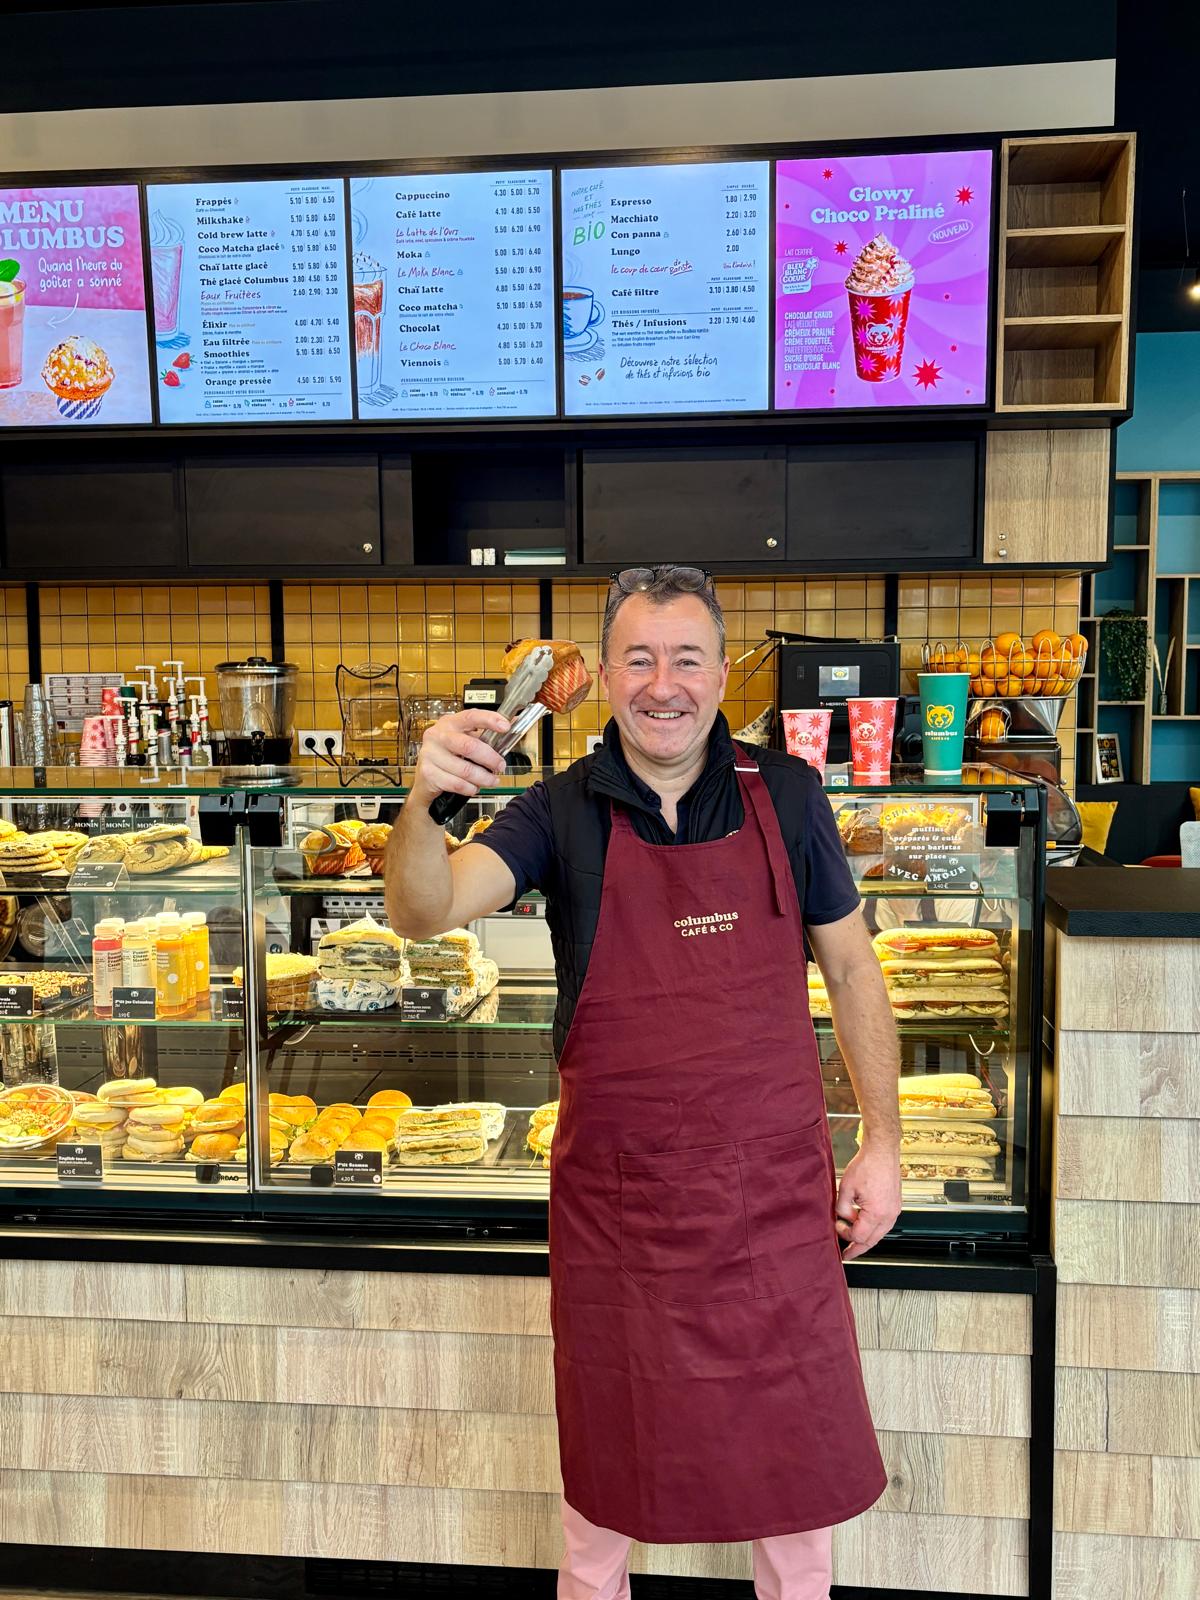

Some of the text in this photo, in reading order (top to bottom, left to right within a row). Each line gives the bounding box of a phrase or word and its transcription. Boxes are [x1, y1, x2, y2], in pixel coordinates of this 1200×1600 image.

[395, 192, 450, 201] Cappuccino
[511, 188, 523, 196] 5.00
[849, 187, 914, 203] Glowy
[195, 198, 232, 207] Frappés
[322, 196, 335, 204] 6.50
[611, 198, 652, 207] Espresso
[0, 200, 84, 224] MENU
[396, 210, 441, 219] Café latte
[811, 203, 945, 224] Choco Praliné
[196, 216, 244, 225] Milkshake
[290, 213, 336, 222] 5.10 6.50
[611, 214, 659, 224] Macchiato
[197, 230, 268, 240] Cold brew latte
[396, 228, 404, 237] Le
[406, 227, 427, 236] Latte
[429, 227, 438, 236] de
[611, 231, 661, 240] Con panna
[726, 228, 740, 237] 2.60
[931, 221, 969, 241] NOUVEAU
[0, 226, 125, 250] LUMBUS
[199, 243, 280, 254] Coco Matcha glacé
[324, 243, 337, 252] 6.50
[726, 244, 740, 252] 2.00
[397, 251, 423, 259] Moka
[611, 248, 641, 257] Lungo
[38, 256, 123, 273] Quand l'heure du
[199, 261, 268, 272] Chaï latte glacé
[325, 261, 337, 269] 6.50
[611, 264, 619, 274] le
[620, 267, 638, 276] coup
[639, 264, 649, 274] de
[669, 260, 693, 275] Barista
[787, 262, 804, 270] BLEU
[397, 266, 455, 278] Le Moka Blanc
[784, 268, 807, 276] BLANC
[40, 274, 122, 292] goûter a sonné
[200, 275, 289, 287] Thé glacé Columbus
[398, 285, 444, 294] Chaï latte
[611, 288, 660, 297] Café filtre
[398, 303, 458, 312] Coco matcha
[496, 302, 509, 310] 5.10
[784, 311, 833, 320] CHOCOLAT CHAUD
[202, 320, 227, 329] Élixir
[612, 320, 634, 328] Thés
[643, 318, 687, 327] Infusions
[400, 324, 441, 333] Chocolat
[203, 337, 250, 347] Eau filtrée
[400, 341, 457, 351] Le Choco Blanc
[203, 350, 250, 358] Smoothies
[400, 359, 442, 367] Viennois
[620, 353, 718, 368] Découvrez notre sélection
[793, 362, 821, 371] CHOCOLAT
[822, 361, 841, 370] BLANC
[626, 366, 711, 381] de thés et infusions bio
[205, 376, 272, 387] Orange pressée
[885, 803, 935, 822] CHAQUE
[74, 819, 99, 828] MONIN
[106, 819, 131, 828] MONIN
[137, 820, 160, 828] MON
[888, 865, 967, 882] AVEC AMOUR
[673, 911, 739, 928] columbus
[681, 923, 733, 937] CAFÉ & CO
